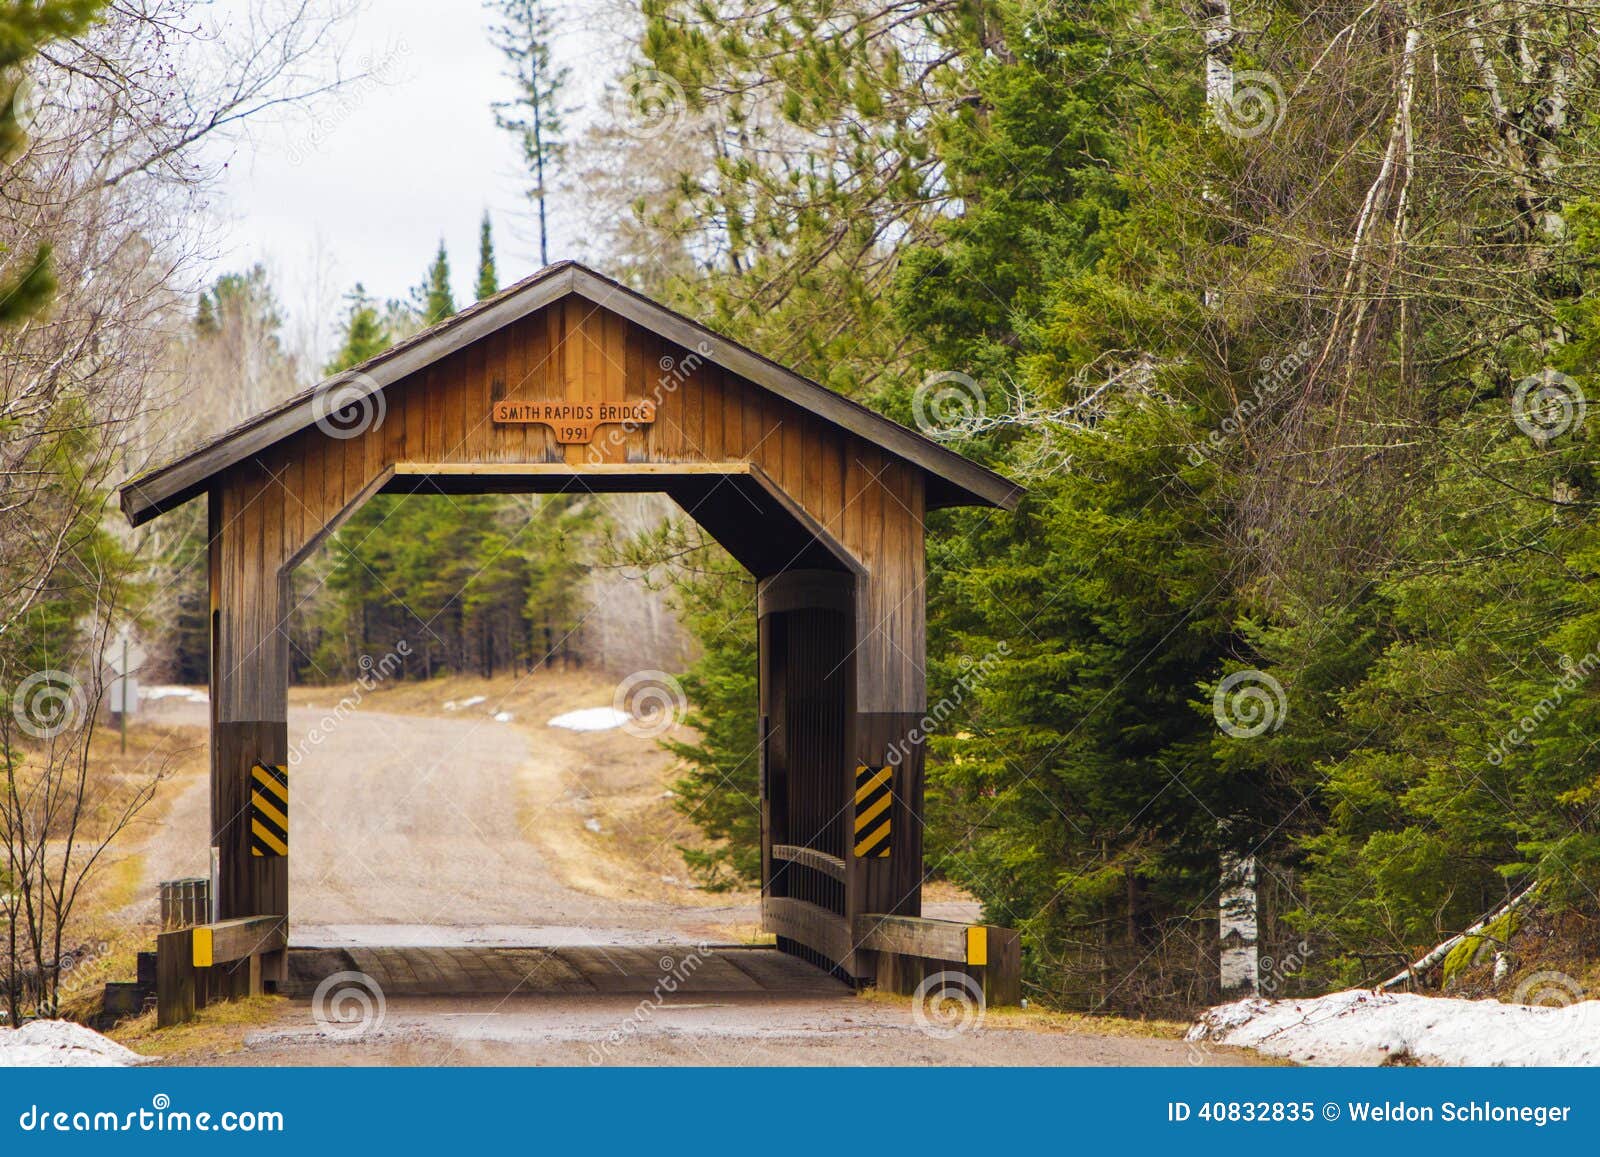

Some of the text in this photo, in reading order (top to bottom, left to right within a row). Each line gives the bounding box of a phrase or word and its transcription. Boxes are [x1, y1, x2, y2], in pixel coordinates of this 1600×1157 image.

[500, 406, 648, 420] SMITH RAPIDS BRIDGE
[560, 427, 588, 440] 1991
